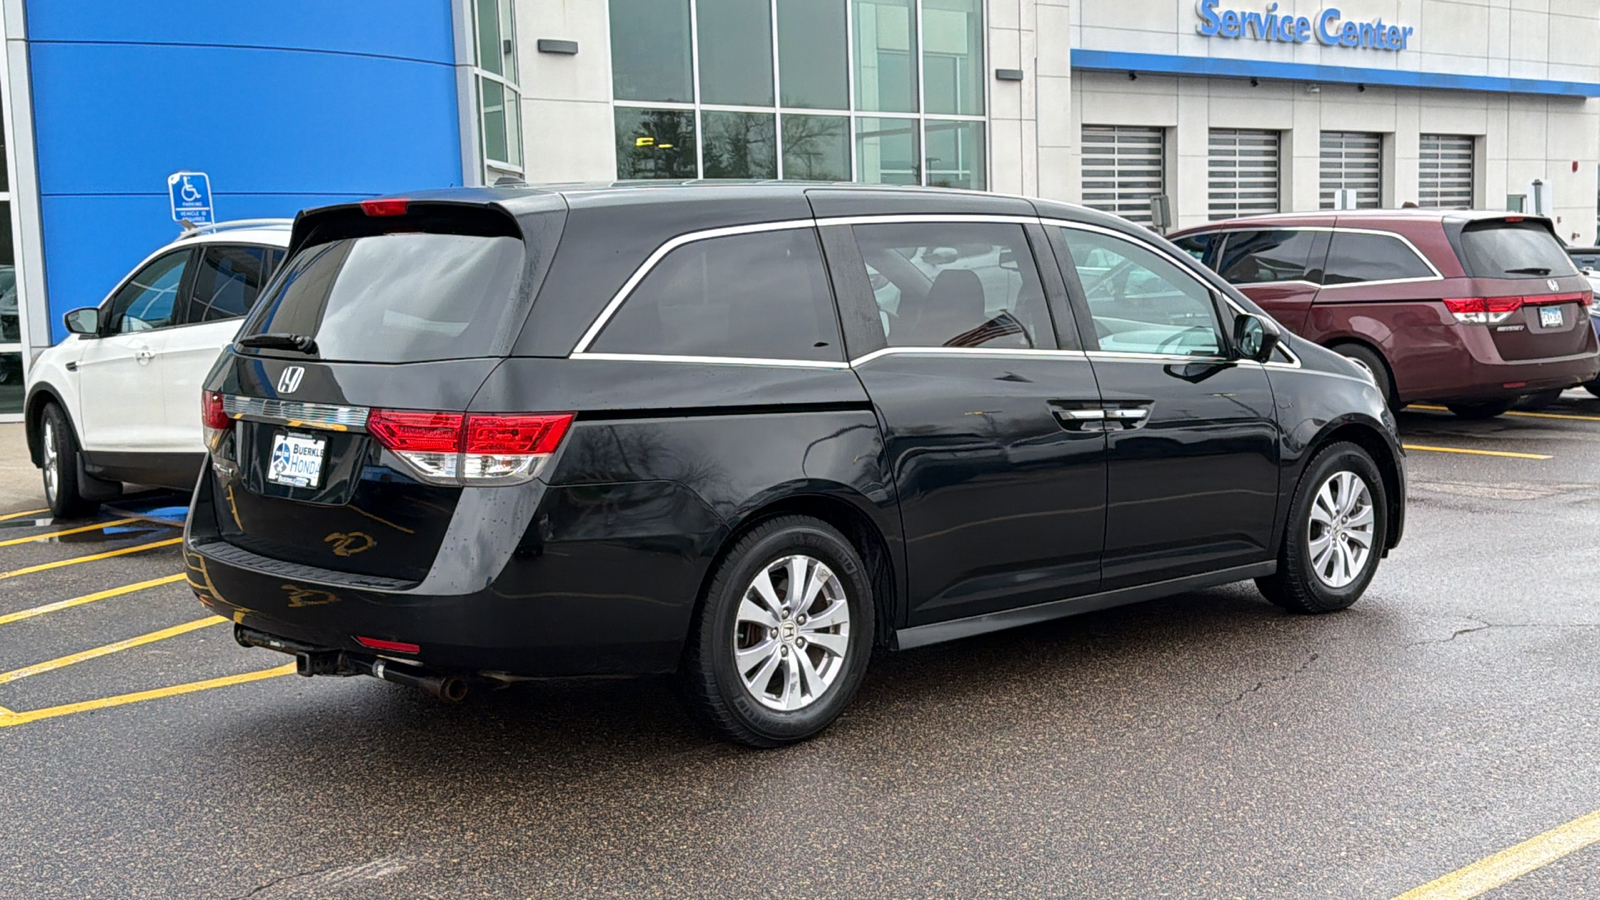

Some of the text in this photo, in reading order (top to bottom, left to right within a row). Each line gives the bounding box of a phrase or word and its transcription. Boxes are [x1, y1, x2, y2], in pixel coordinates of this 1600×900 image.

[1196, 0, 1414, 50] Service Center
[293, 443, 324, 457] BUERKLE
[290, 456, 321, 475] HONDA
